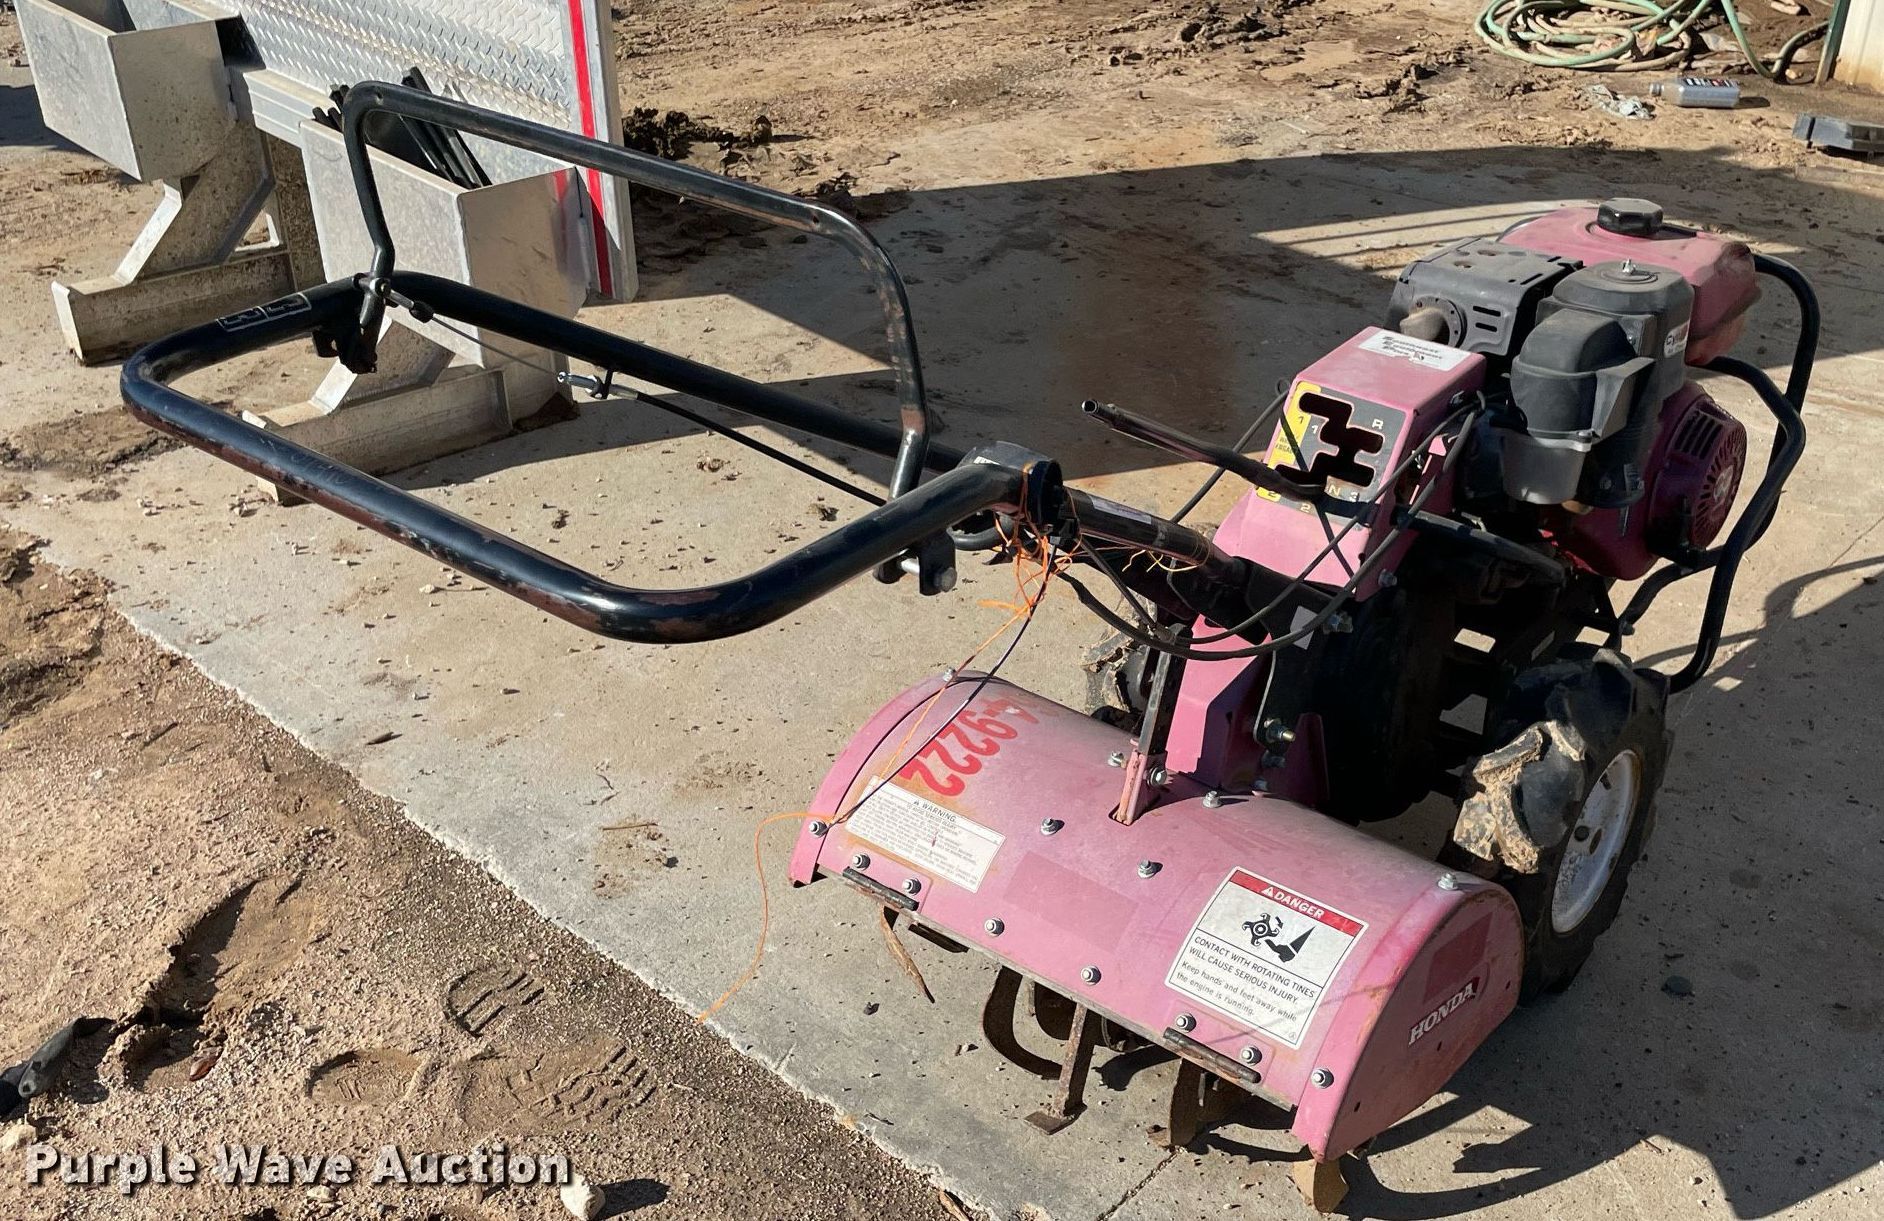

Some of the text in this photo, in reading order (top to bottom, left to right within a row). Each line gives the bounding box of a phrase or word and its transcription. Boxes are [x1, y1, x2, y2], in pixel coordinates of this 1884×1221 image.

[1311, 425, 1318, 434] 1
[1372, 418, 1384, 430] R
[1328, 485, 1341, 496] N
[1300, 503, 1312, 513] 2
[922, 802, 957, 823] WARNING
[1273, 890, 1325, 920] DANGER
[1189, 946, 1298, 1005] WILL CAUSE SERIOUS INJURY.
[1194, 936, 1315, 998] CONTACT WITH ROTATING TINES
[1177, 972, 1255, 1016] the engine is running.
[1182, 961, 1297, 1021] Keep hands and feet away while
[1408, 982, 1476, 1047] HONDA
